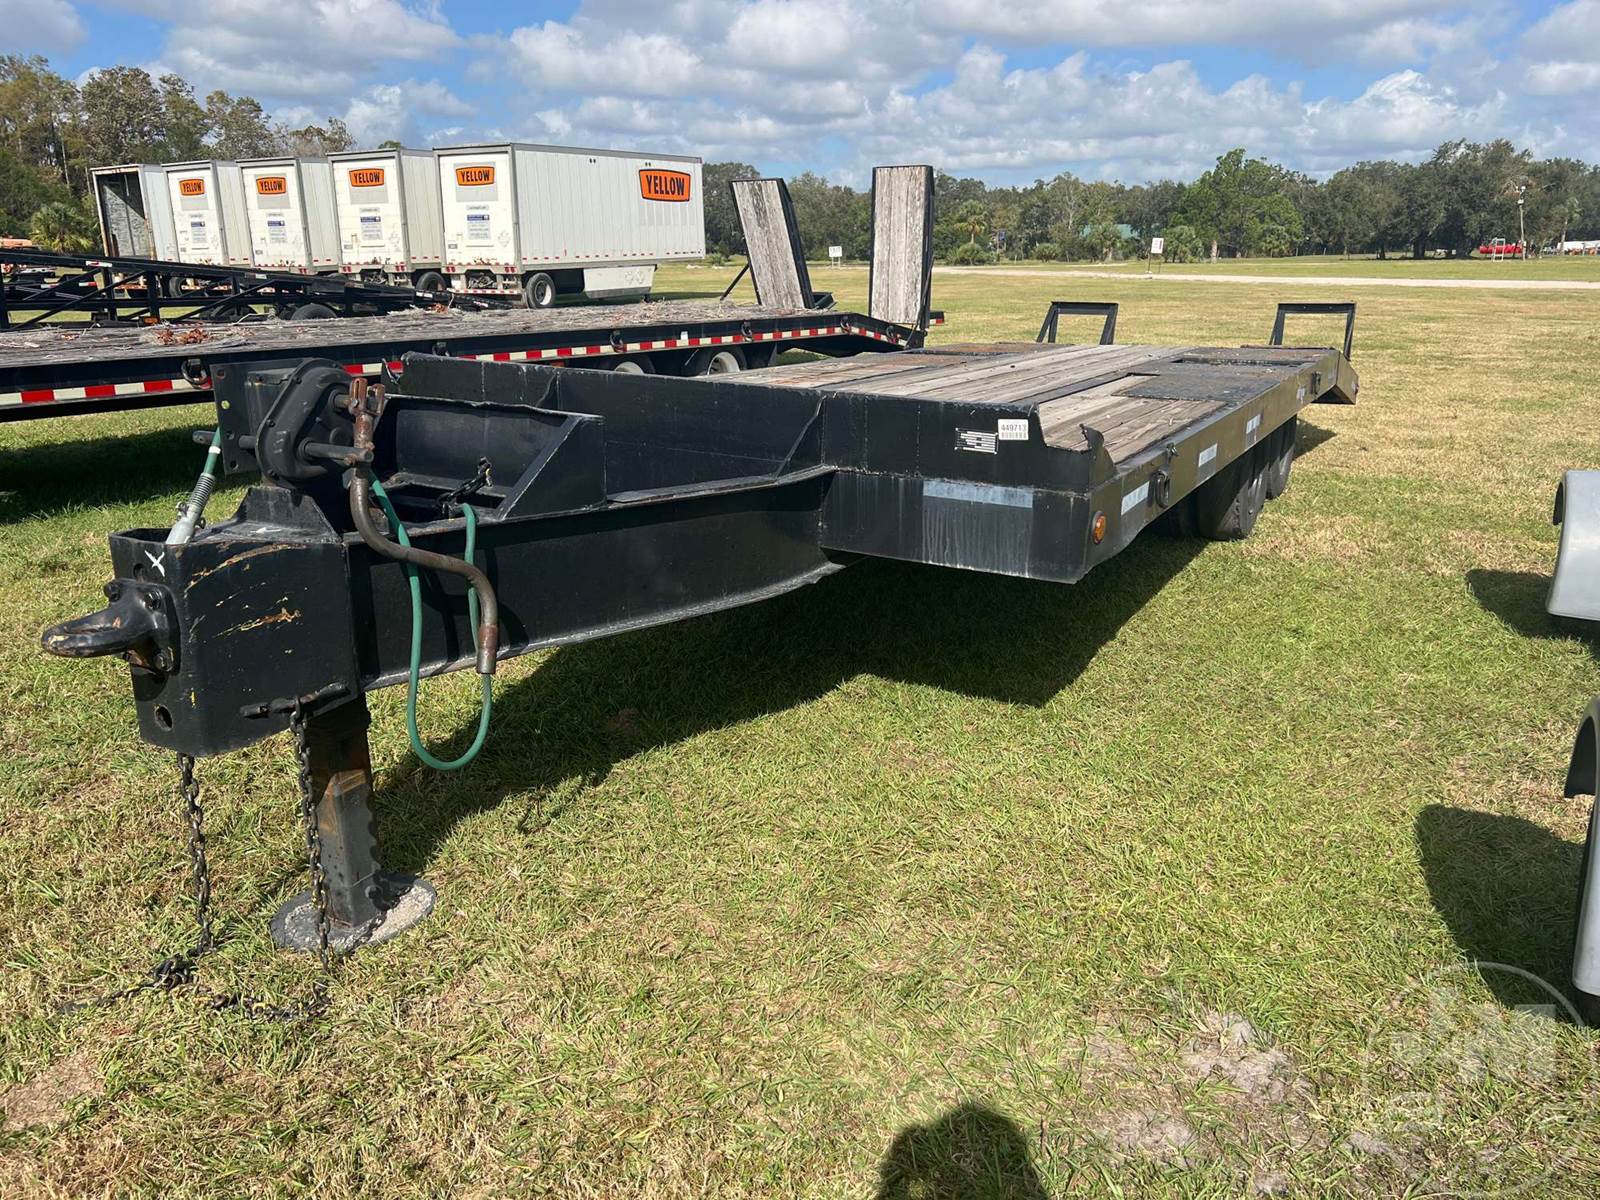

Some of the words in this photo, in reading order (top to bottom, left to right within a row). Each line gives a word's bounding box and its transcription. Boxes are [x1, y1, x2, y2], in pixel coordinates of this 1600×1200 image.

[354, 172, 380, 185] YELLOW
[461, 169, 490, 183] YELLOW
[182, 181, 202, 193] YELLOW
[259, 180, 283, 192] YELLOW
[646, 174, 685, 196] YELLOW
